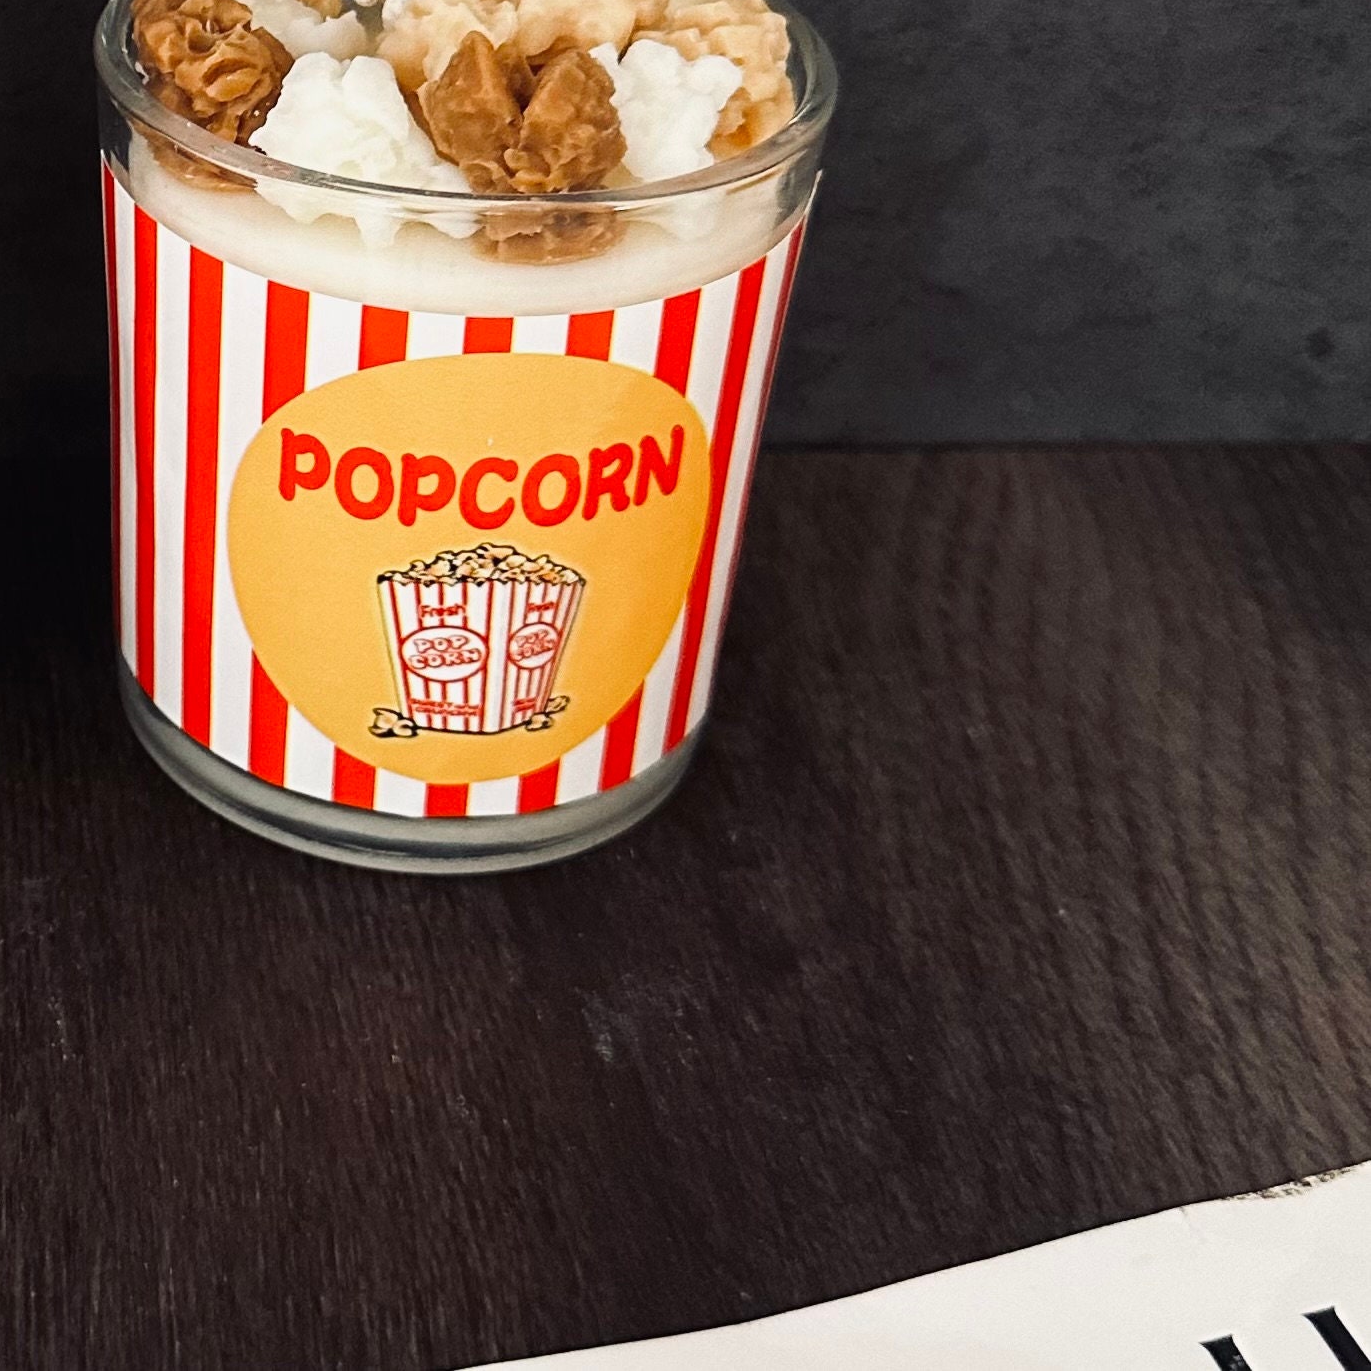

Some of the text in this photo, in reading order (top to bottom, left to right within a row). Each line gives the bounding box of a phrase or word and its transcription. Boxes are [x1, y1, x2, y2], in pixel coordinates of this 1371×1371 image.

[279, 425, 685, 530] POPCORN
[420, 604, 466, 618] Fresh
[414, 634, 468, 654] POP
[408, 648, 482, 670] CORN
